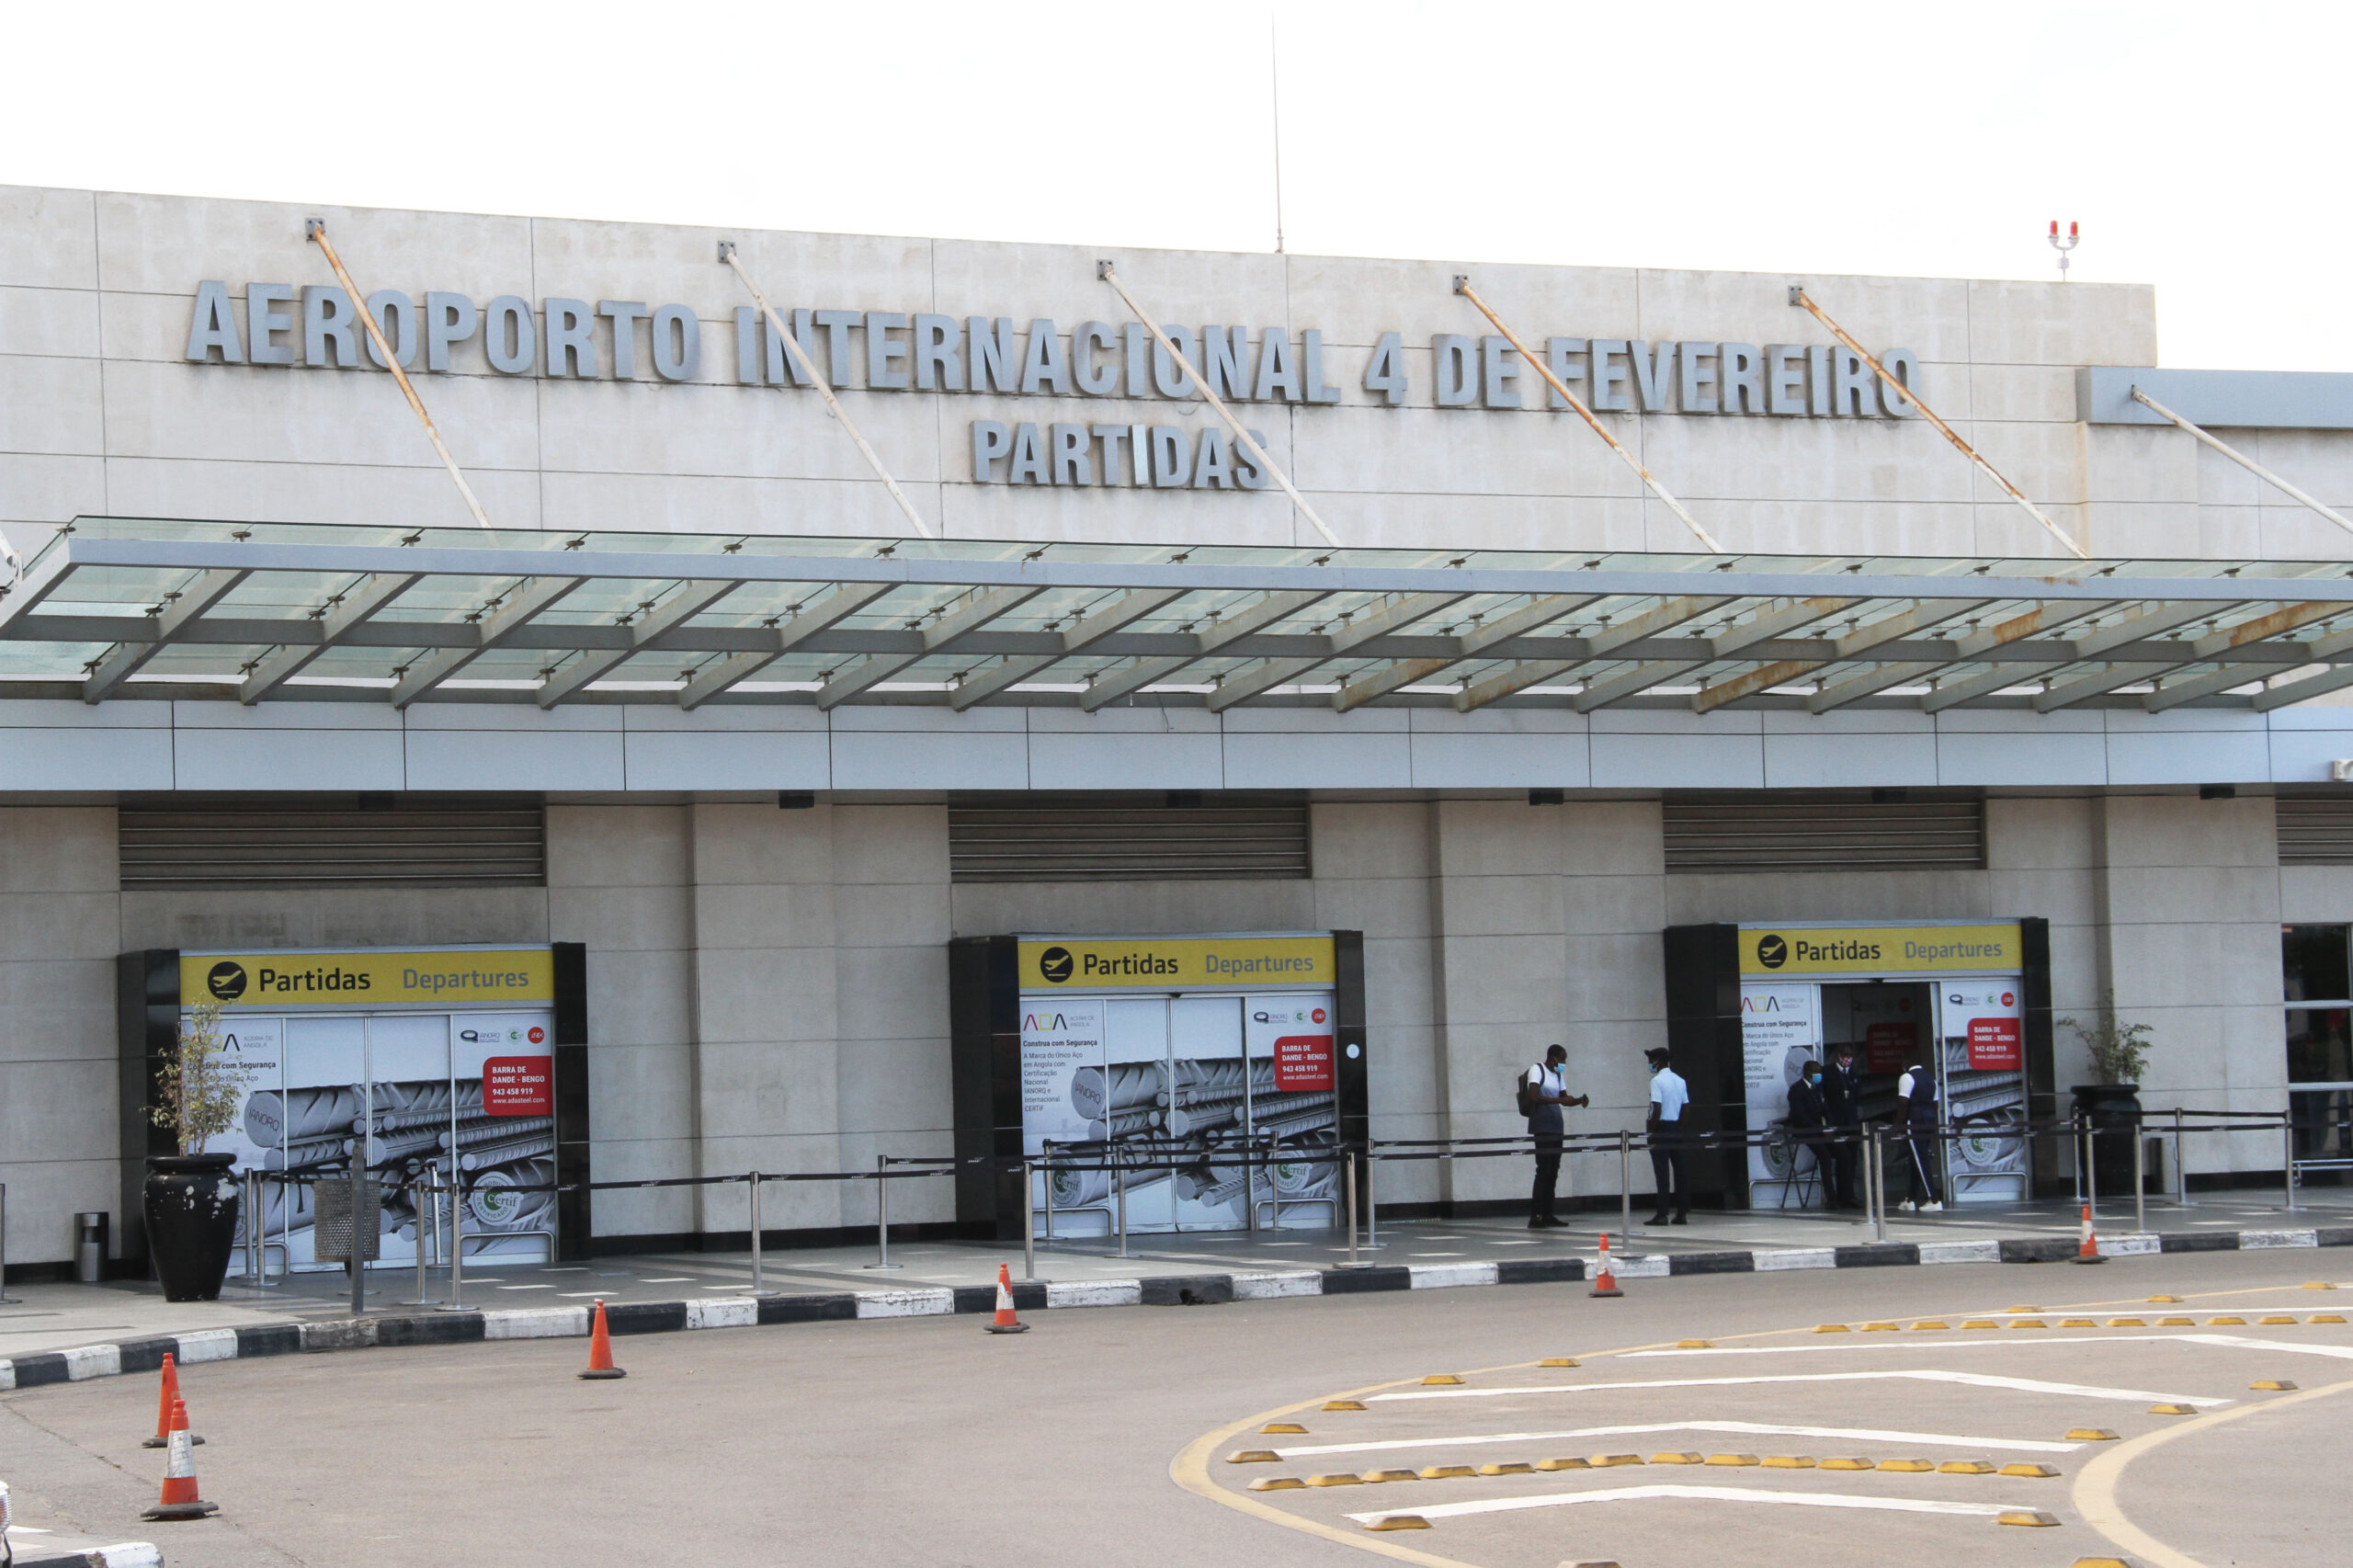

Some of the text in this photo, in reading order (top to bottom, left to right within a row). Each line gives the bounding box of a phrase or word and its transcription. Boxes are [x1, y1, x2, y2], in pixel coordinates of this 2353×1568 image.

[186, 280, 1921, 418] AEROPORTO INTERNACIONAL 4 DE FEVEREIRO
[969, 420, 1269, 489] PARTIDAS
[1796, 940, 2003, 962] Partidas Departures
[1083, 953, 1313, 977] Partidas Departures
[259, 968, 529, 994] Partidas Departures
[1034, 1061, 1052, 1069] Angola
[487, 1195, 517, 1207] Certif
